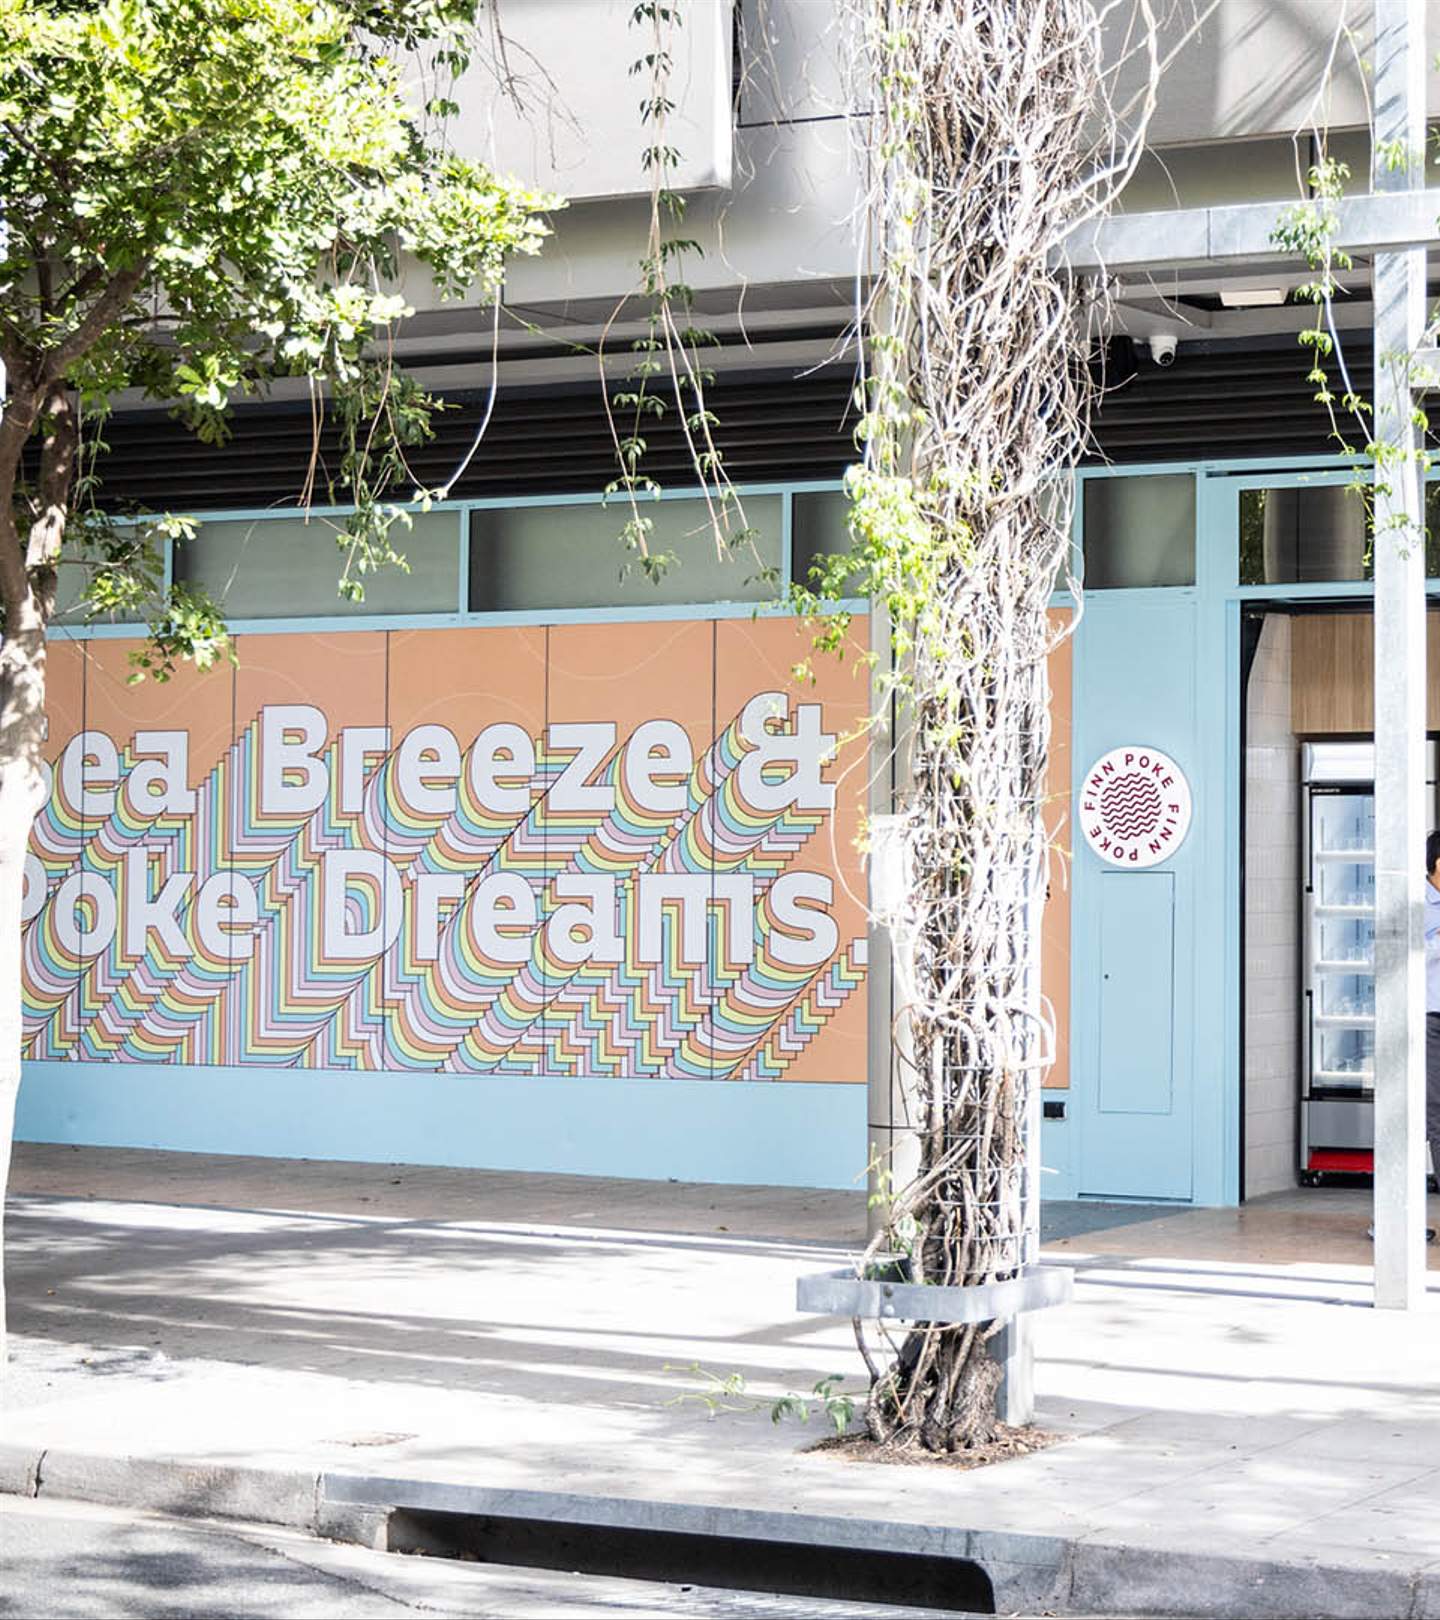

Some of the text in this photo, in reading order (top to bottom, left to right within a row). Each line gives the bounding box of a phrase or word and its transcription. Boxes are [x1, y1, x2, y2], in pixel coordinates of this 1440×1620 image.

[37, 690, 837, 817] ea Breeze &
[1085, 753, 1174, 811] FINN POKE
[1089, 804, 1179, 861] FINN POKE
[323, 848, 869, 967] Dreams.
